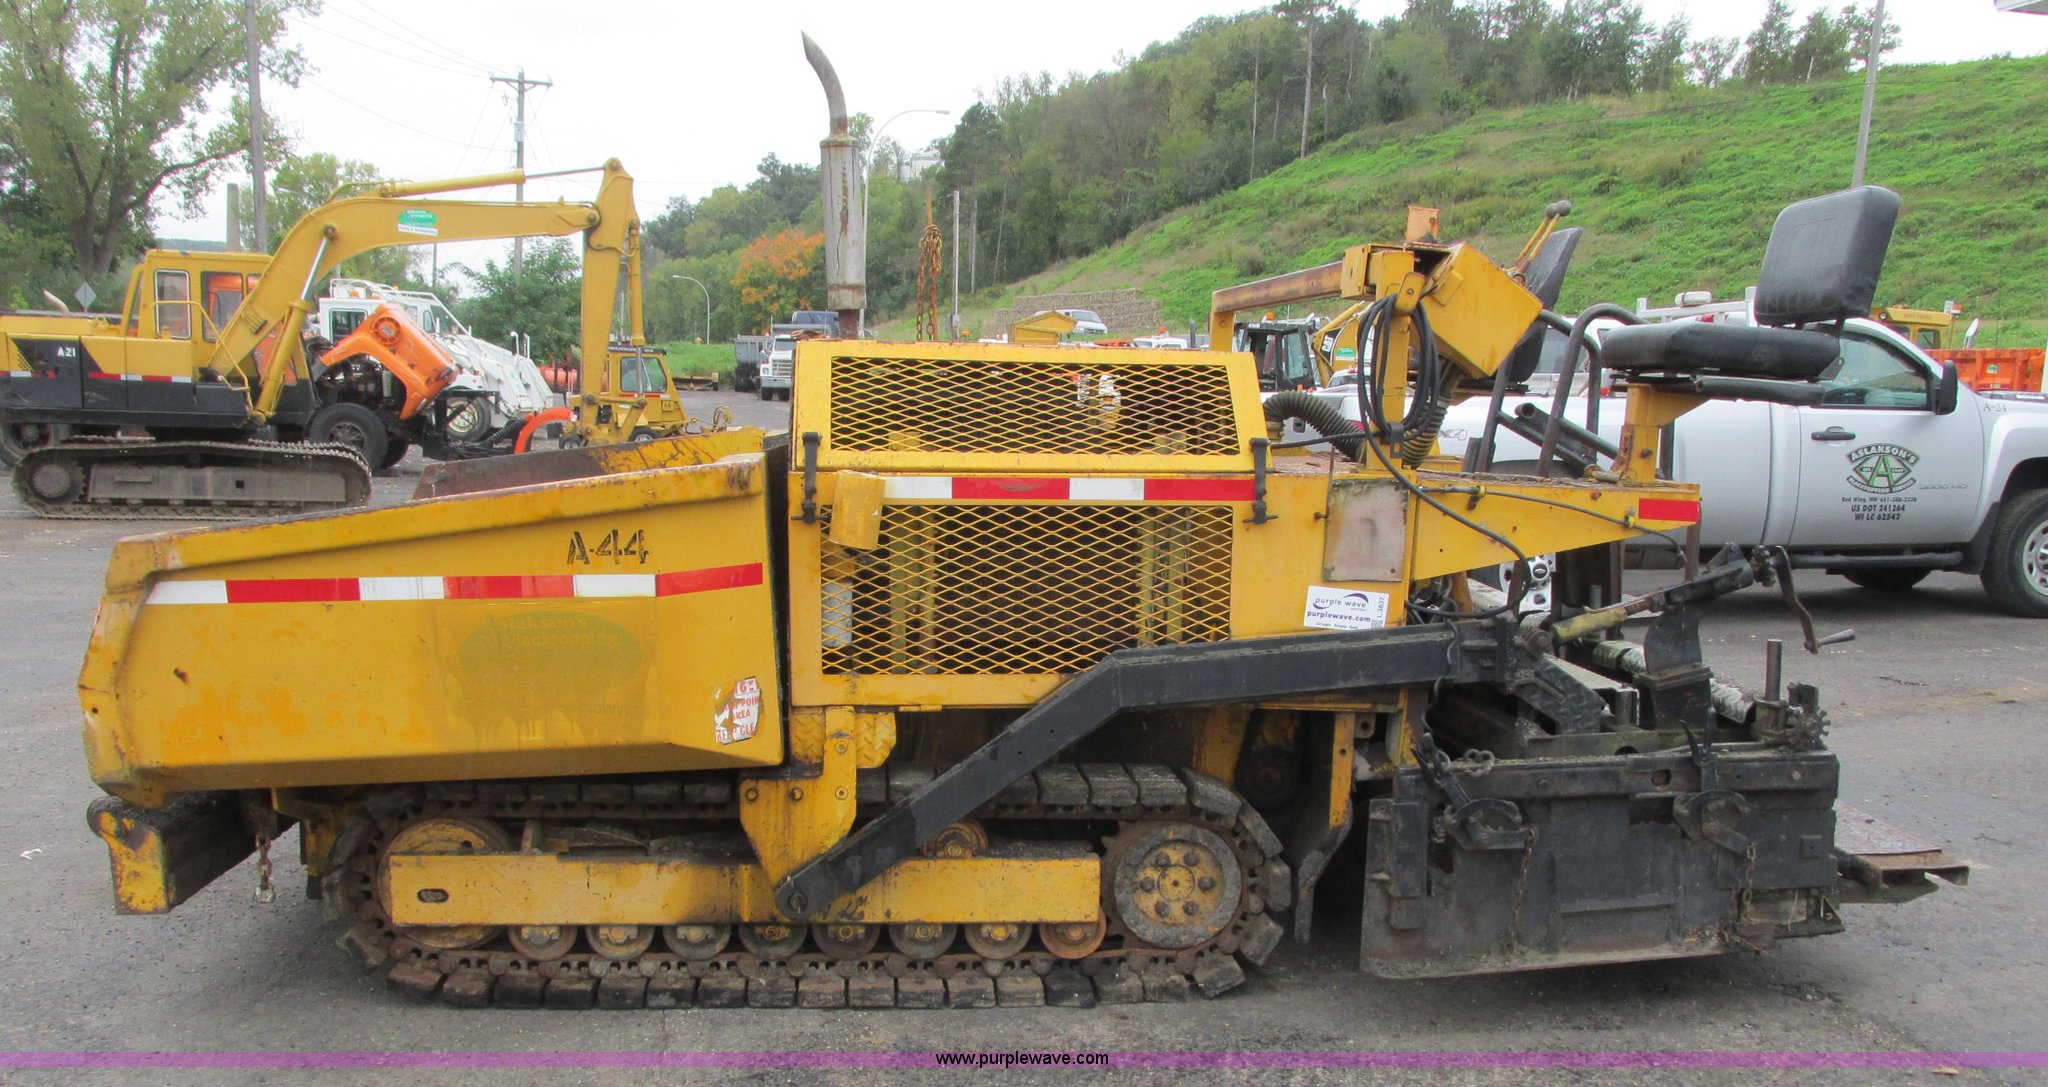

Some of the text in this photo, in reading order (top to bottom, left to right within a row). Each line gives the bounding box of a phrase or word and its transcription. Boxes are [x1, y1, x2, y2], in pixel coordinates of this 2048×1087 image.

[1322, 334, 1334, 352] CAT
[1984, 402, 2006, 413] A-24
[1850, 444, 1918, 465] ASLAKSON'S
[1851, 504, 1905, 512] US DOT 241264
[1854, 513, 1901, 521] WI LC 62542
[566, 529, 649, 565] A-44
[1315, 597, 1367, 608] purple wave
[1307, 610, 1371, 623] purplewave.com
